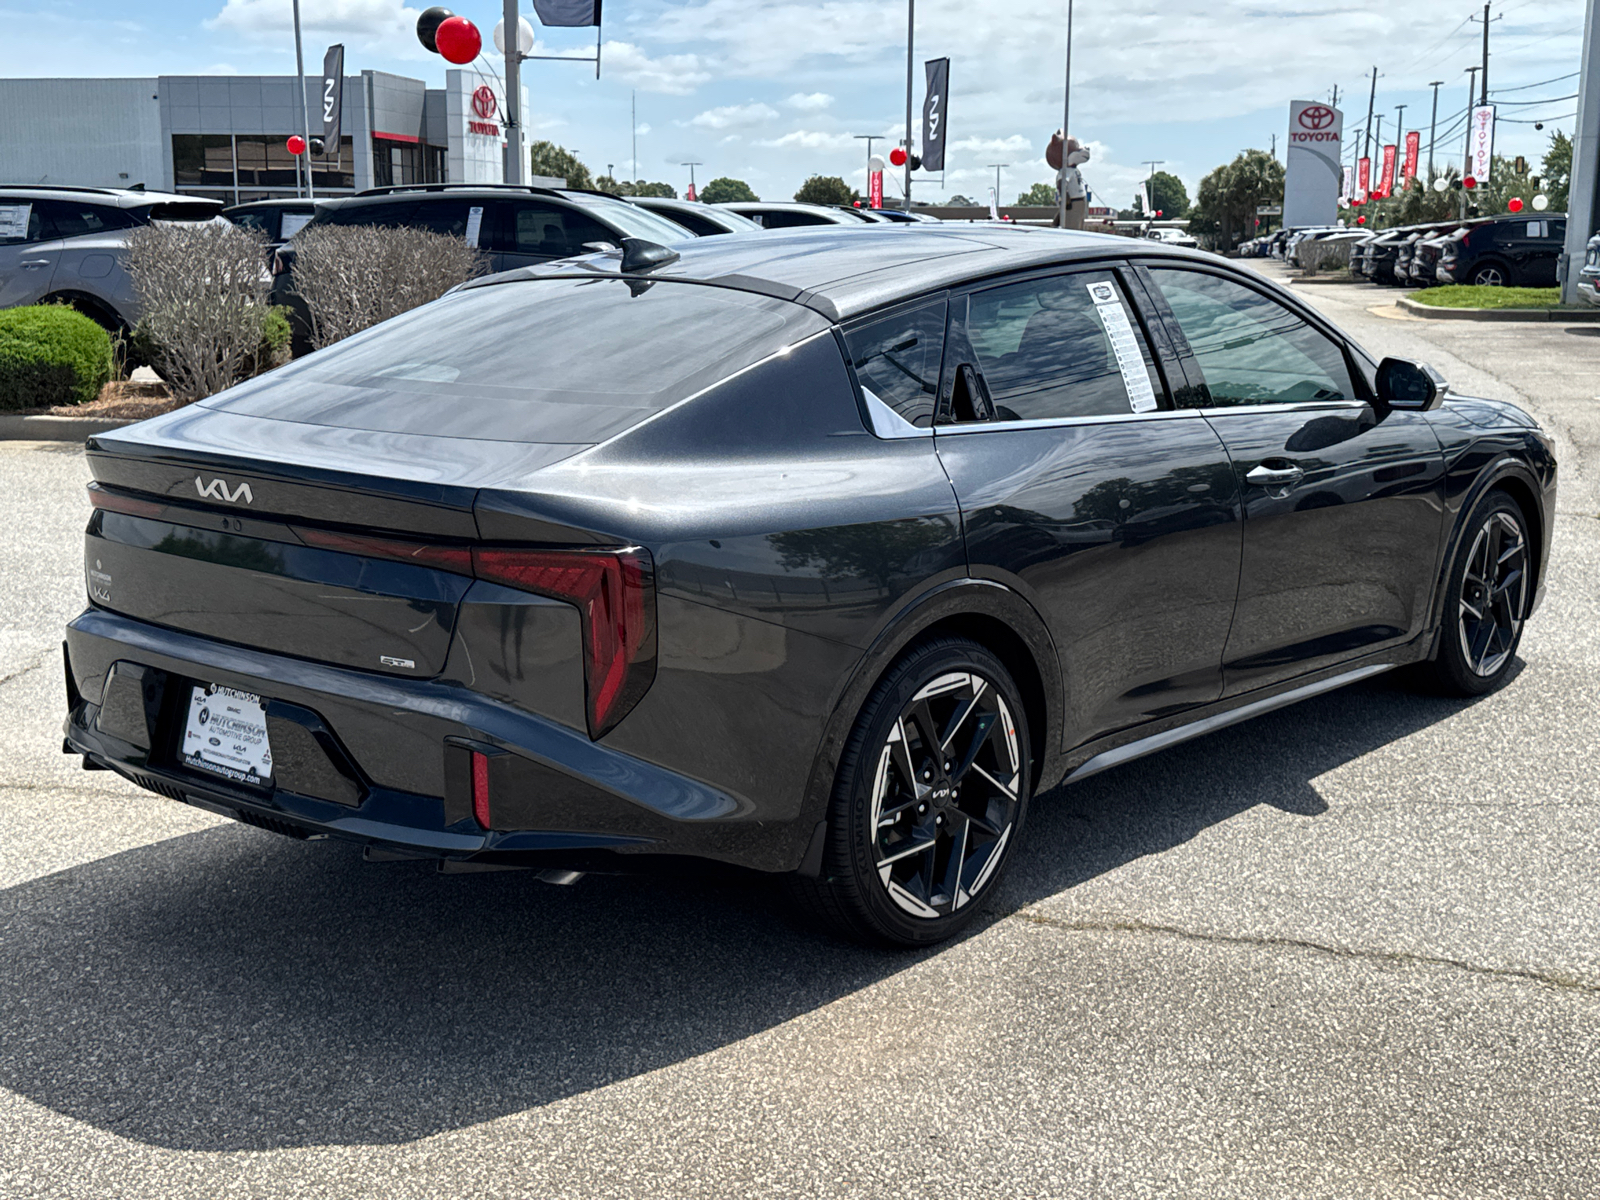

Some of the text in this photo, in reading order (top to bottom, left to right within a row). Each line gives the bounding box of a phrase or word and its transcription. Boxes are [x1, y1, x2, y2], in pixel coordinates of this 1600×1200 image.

[469, 121, 500, 136] TOYOTA
[1291, 132, 1339, 142] TOYOTA
[1476, 122, 1487, 176] TOYOTA
[195, 476, 253, 504] KIA
[93, 585, 111, 602] K4
[217, 686, 260, 703] HUTCHINSON
[209, 714, 266, 738] HUTCHINSON
[209, 725, 243, 741] AUTOMOTIVE
[242, 735, 263, 745] GROUP
[855, 797, 869, 877] KUMHO
